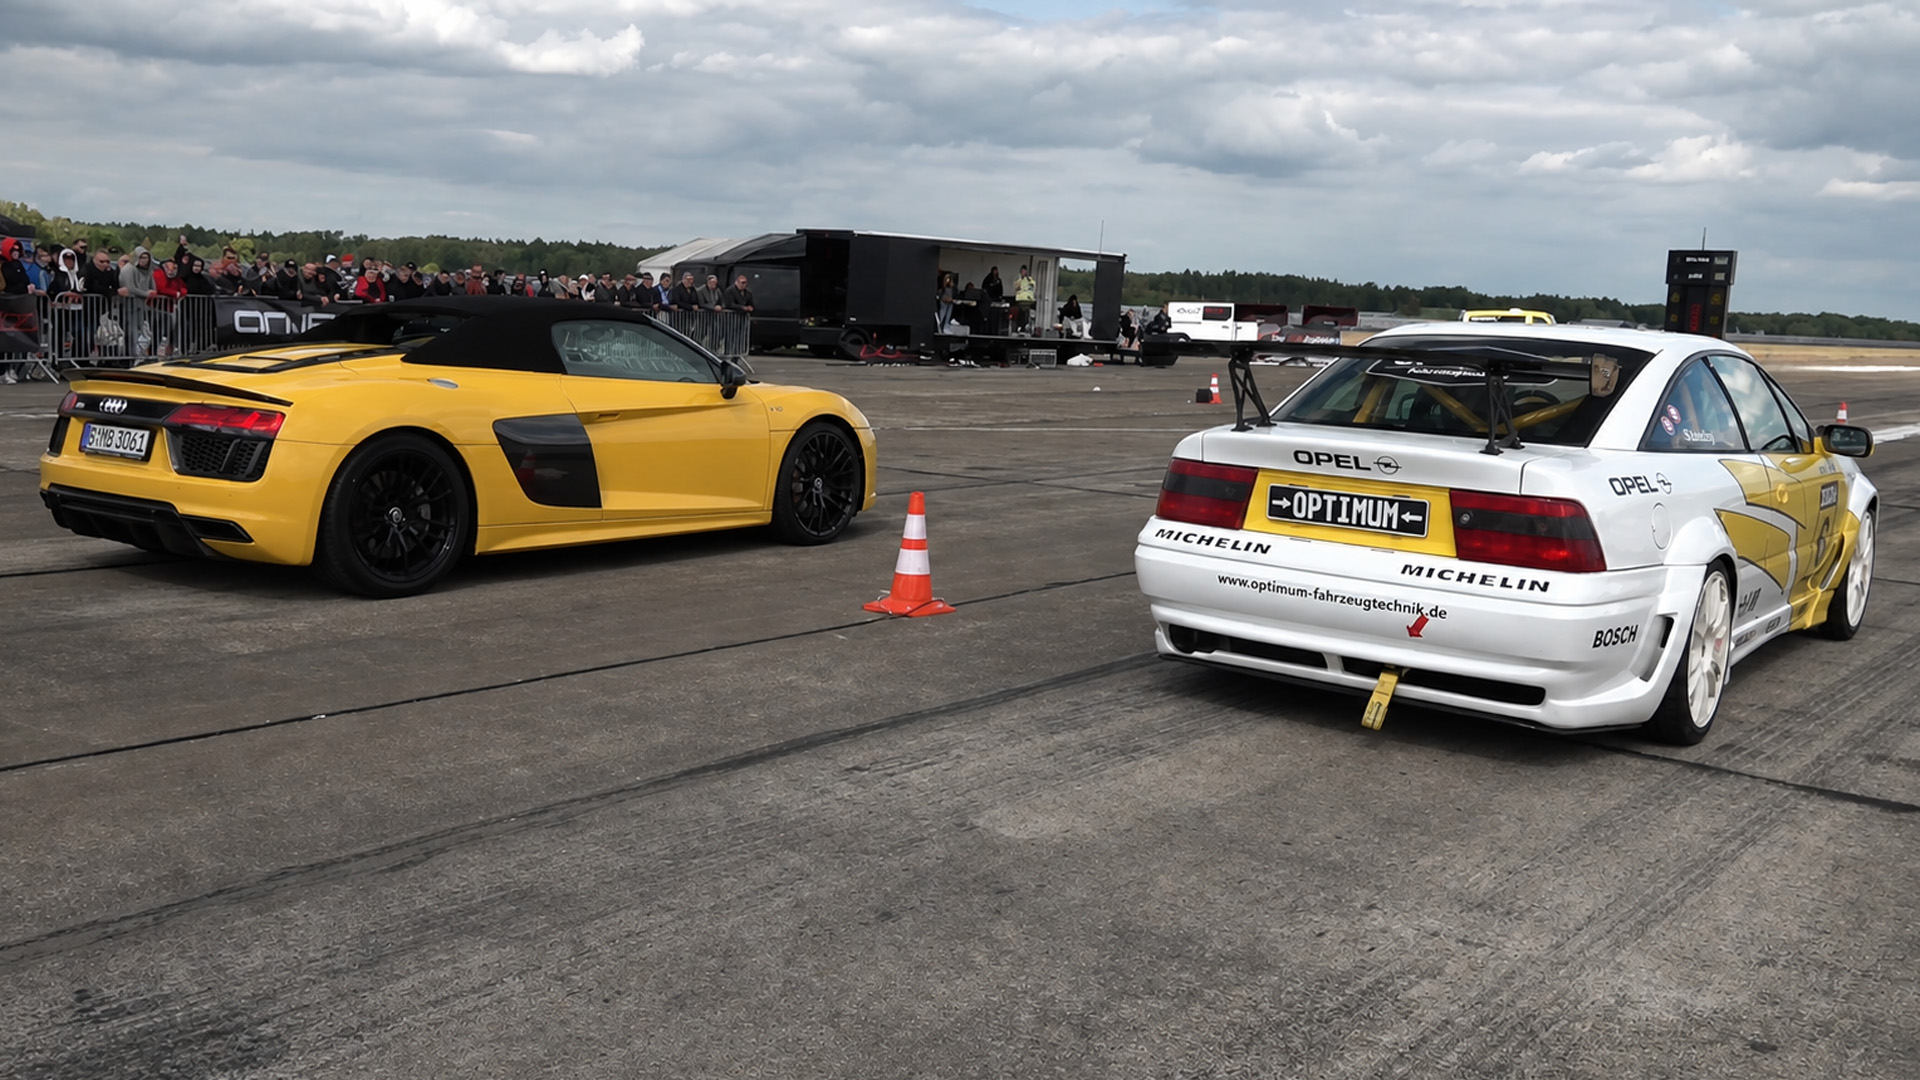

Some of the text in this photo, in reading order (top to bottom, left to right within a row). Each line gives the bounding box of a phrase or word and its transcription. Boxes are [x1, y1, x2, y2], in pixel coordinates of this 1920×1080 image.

[115, 430, 145, 453] 3061
[1293, 450, 1371, 471] OPEL
[1608, 475, 1659, 496] OPEL
[1292, 491, 1399, 529] OPTIMUM
[1155, 529, 1272, 554] MICHELIN
[1401, 564, 1550, 592] MICHELIN
[1218, 574, 1448, 619] www.optimum-fahrzeugtechnik.de
[1592, 625, 1639, 648] BOSCH
